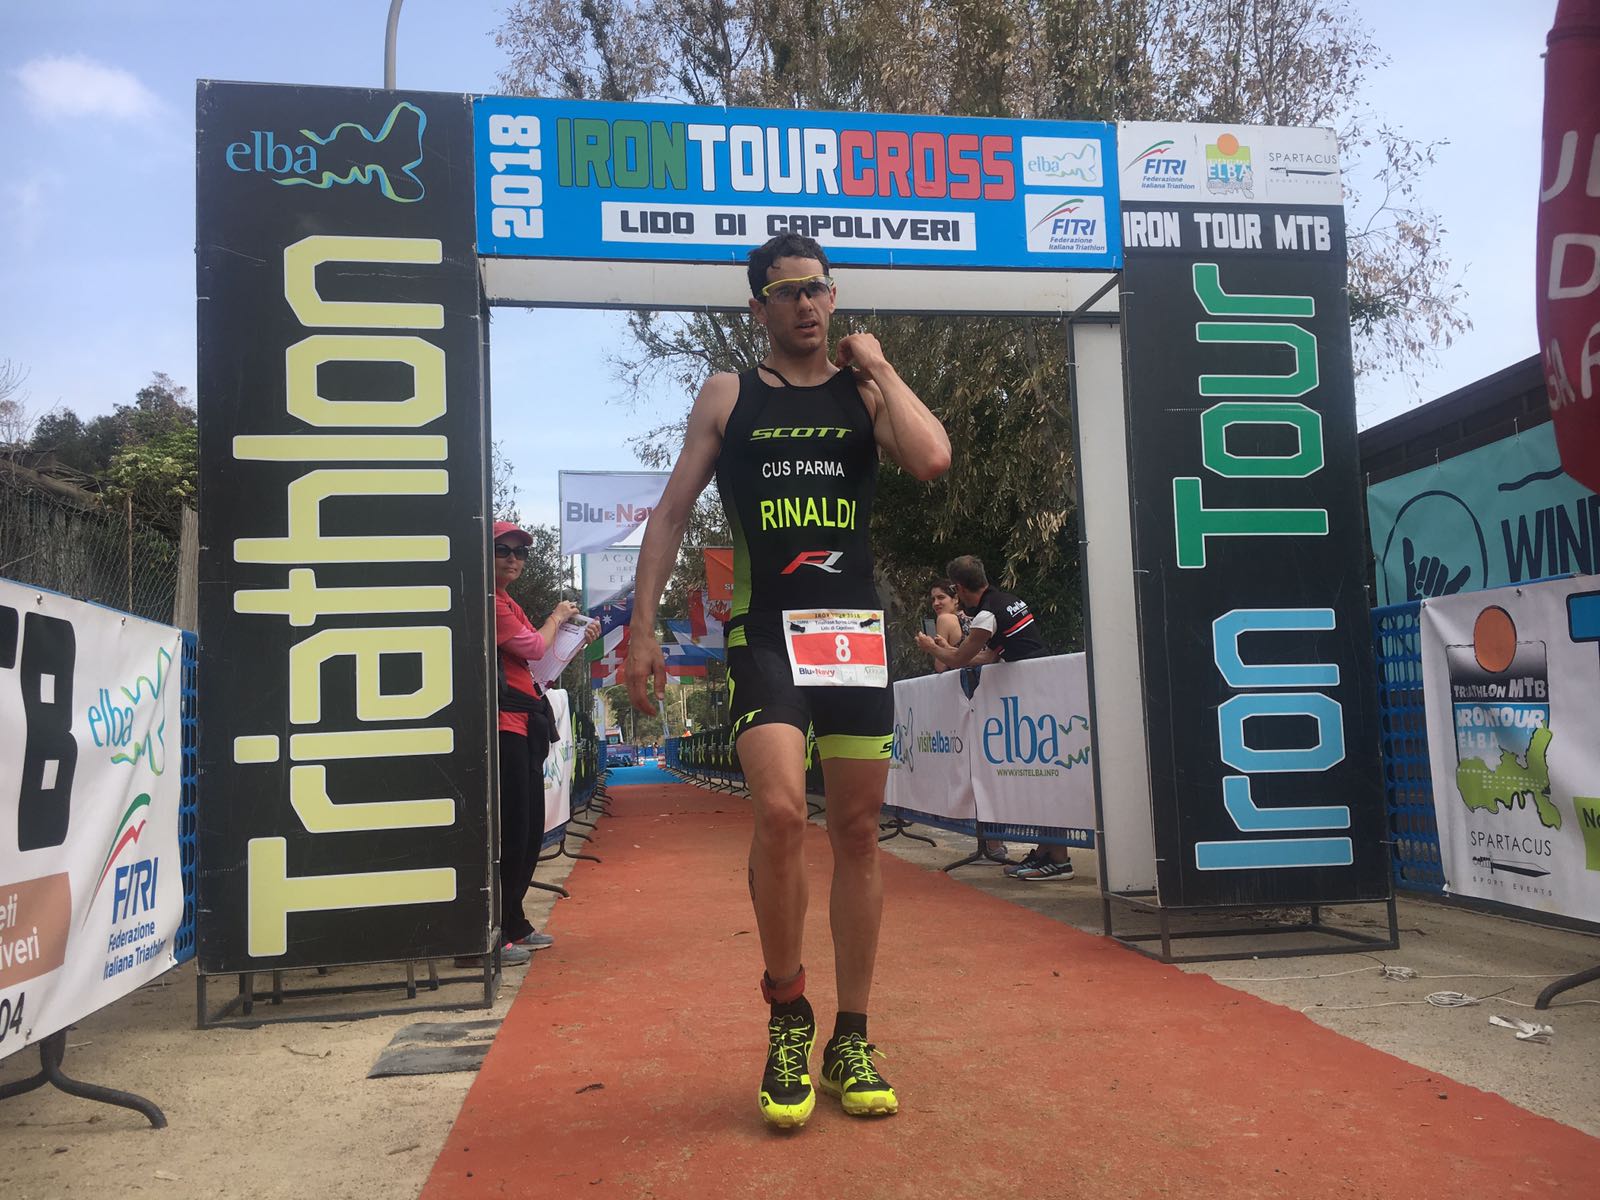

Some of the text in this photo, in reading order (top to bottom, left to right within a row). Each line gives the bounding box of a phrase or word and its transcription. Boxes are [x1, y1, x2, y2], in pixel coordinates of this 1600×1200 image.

[225, 130, 318, 174] elba
[1028, 156, 1060, 172] elba
[1268, 152, 1338, 165] SPARTACUS
[489, 114, 544, 239] 2018
[1142, 175, 1183, 183] Federazione
[1143, 158, 1187, 175] FITRI
[1166, 182, 1196, 190] Triathlon
[620, 210, 961, 242] LIDO DI CAPOLIVERI
[1052, 218, 1097, 236] FITRI
[1122, 211, 1332, 251] IRON TOUR MTB
[1048, 243, 1074, 251] Italiana
[1049, 236, 1093, 244] Federazione
[750, 427, 853, 441] SCOTT
[762, 460, 846, 479] CUS PARMA
[760, 496, 857, 531] RINALDI
[1172, 262, 1354, 871] Iron Tour
[233, 235, 457, 957] Triathlon
[835, 634, 852, 662] 8
[1453, 677, 1546, 698] TRIATHLON MTB
[88, 688, 133, 747] elba
[983, 695, 1059, 765] elba
[1458, 730, 1499, 748] ELBA
[1470, 831, 1552, 857] SPARTACUS
[112, 856, 159, 925] FITRI
[108, 920, 156, 954] Federazione
[104, 952, 134, 981] Italiana
